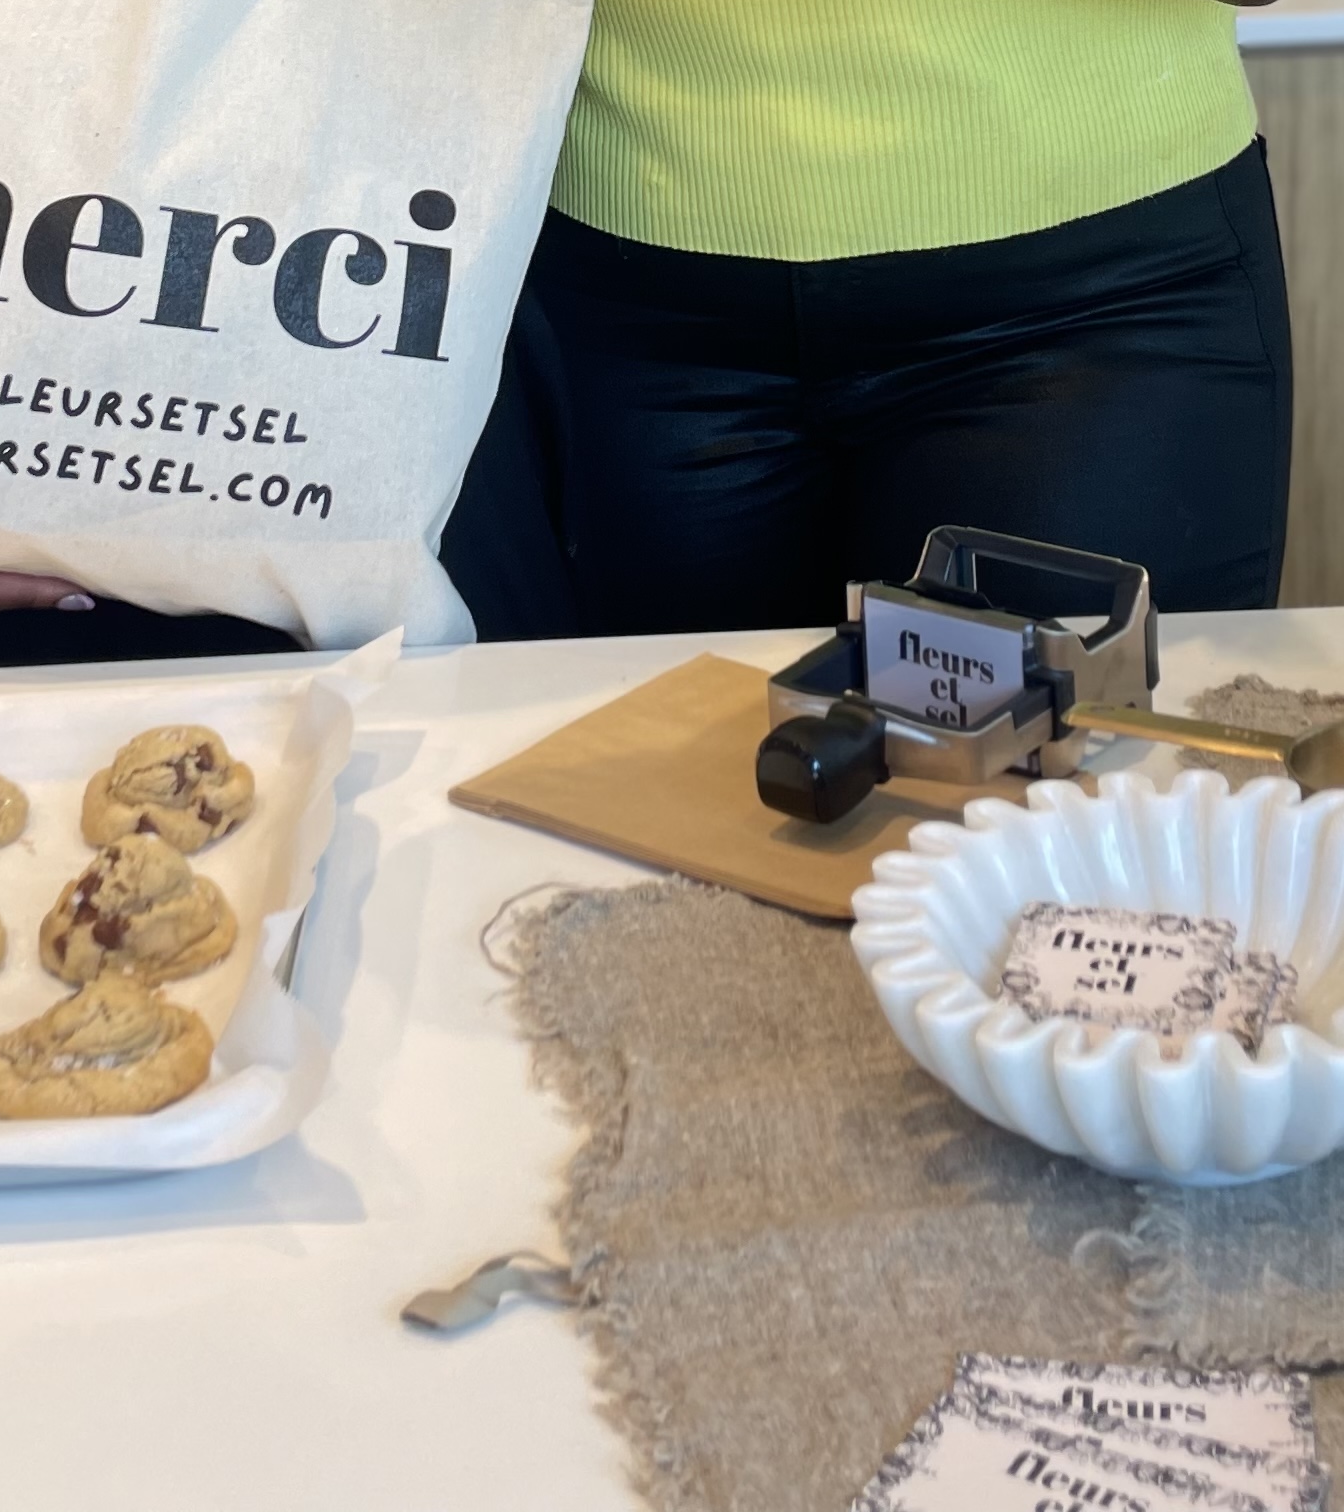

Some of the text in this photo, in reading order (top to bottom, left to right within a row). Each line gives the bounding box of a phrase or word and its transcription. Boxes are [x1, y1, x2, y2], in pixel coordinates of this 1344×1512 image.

[898, 628, 995, 685] fleurs
[929, 676, 964, 707] et
[1052, 929, 1185, 960] fleurs
[1089, 957, 1129, 974] et
[1073, 973, 1138, 994] sel
[1062, 1387, 1207, 1422] fleurs
[1006, 1450, 1152, 1512] fleurs
